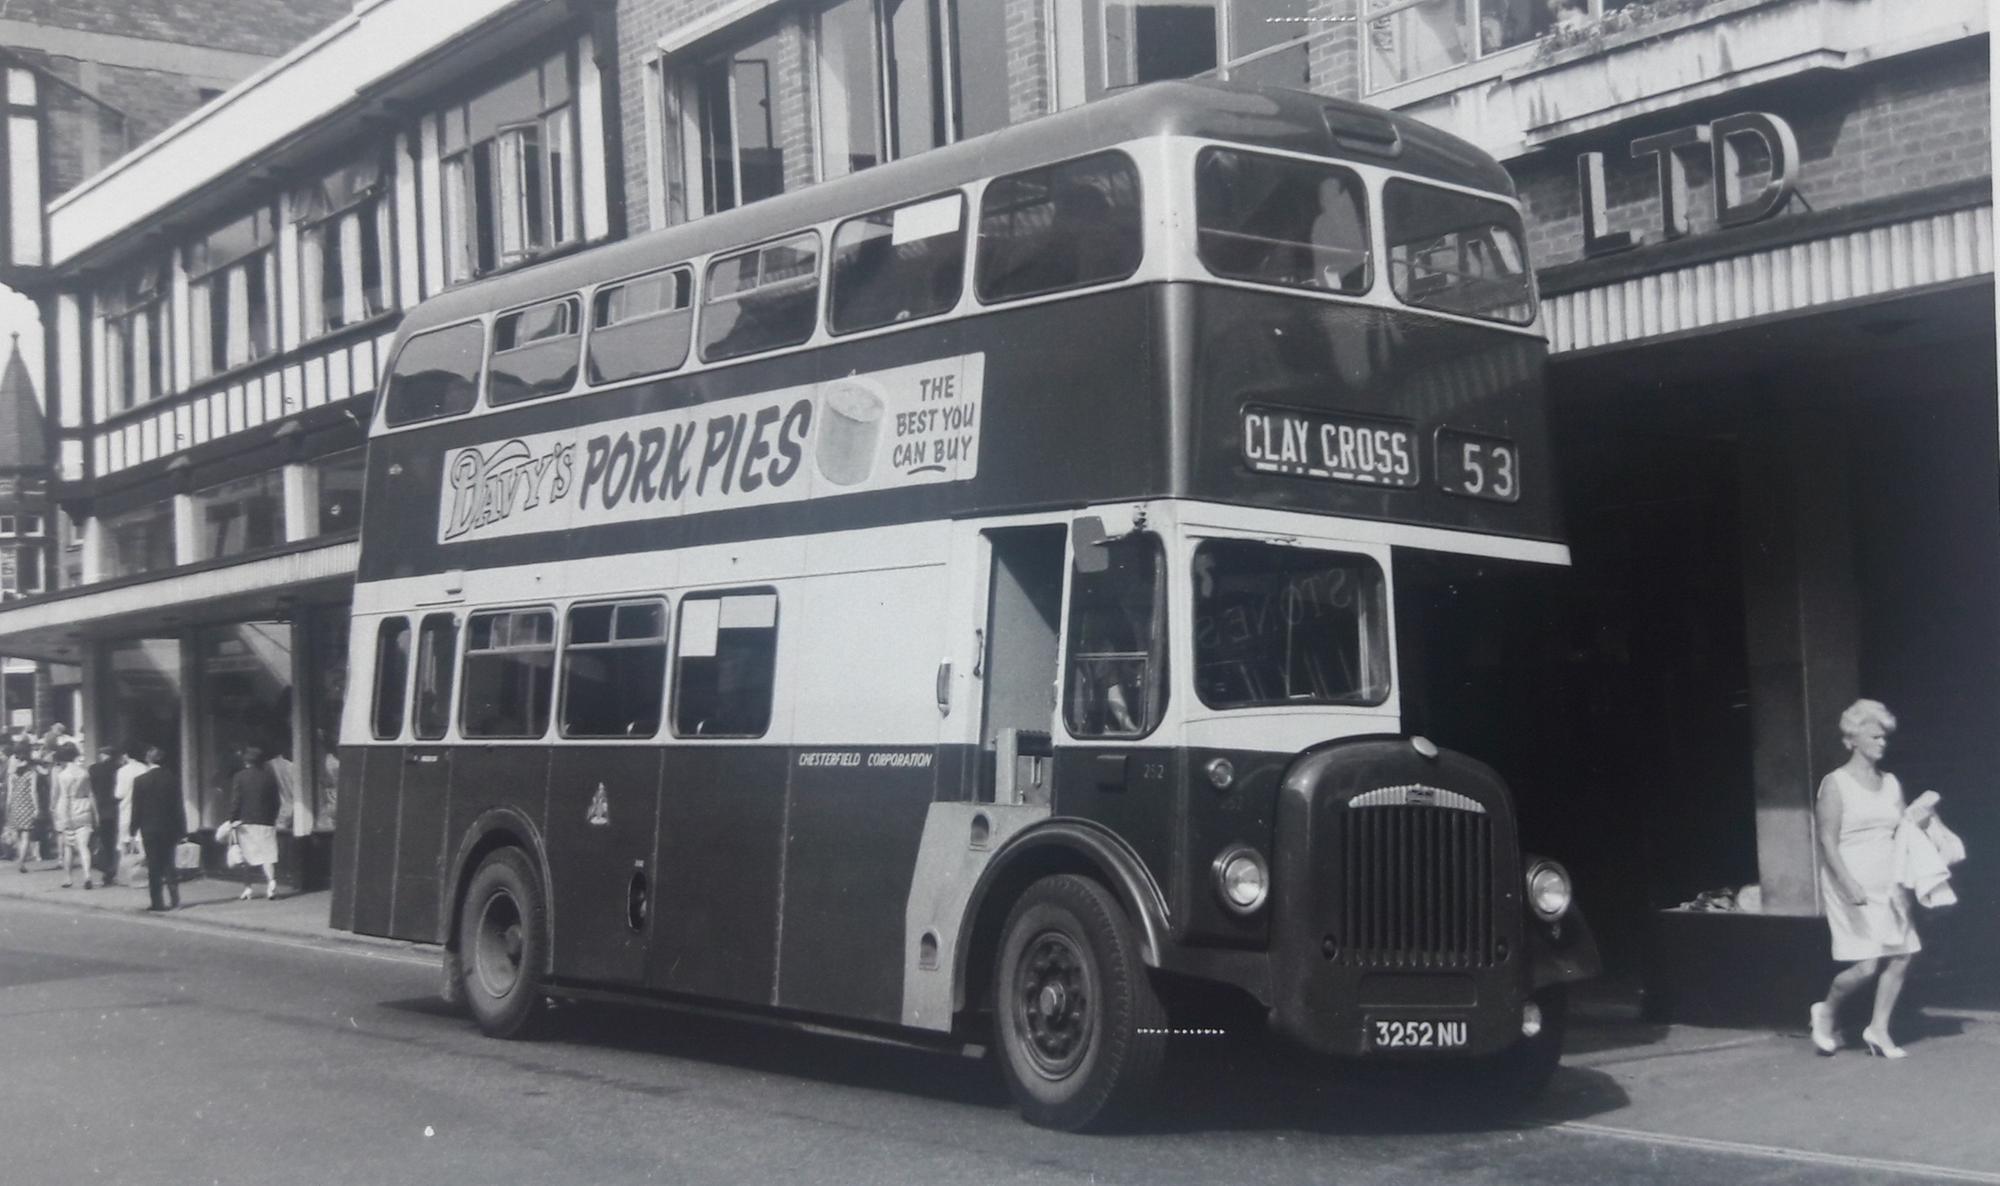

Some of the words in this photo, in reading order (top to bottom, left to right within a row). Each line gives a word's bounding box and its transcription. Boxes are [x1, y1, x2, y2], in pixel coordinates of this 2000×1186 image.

[1577, 111, 1799, 259] LTD
[920, 374, 956, 402] THE
[896, 407, 939, 438] BEST
[942, 402, 975, 432] YOU
[893, 440, 926, 469] CAN
[933, 436, 973, 464] BUY
[1245, 414, 1309, 464] CLAY
[1321, 423, 1410, 475] CROSS
[445, 439, 576, 541] DAVY'S
[580, 420, 697, 511] PORK
[696, 398, 812, 498] PIES
[1463, 442, 1512, 497] 53
[798, 752, 861, 767] CHESTERFIELD
[867, 752, 933, 768] CORPORATION
[1375, 1021, 1434, 1047] 3252
[1438, 1021, 1467, 1047] NU
